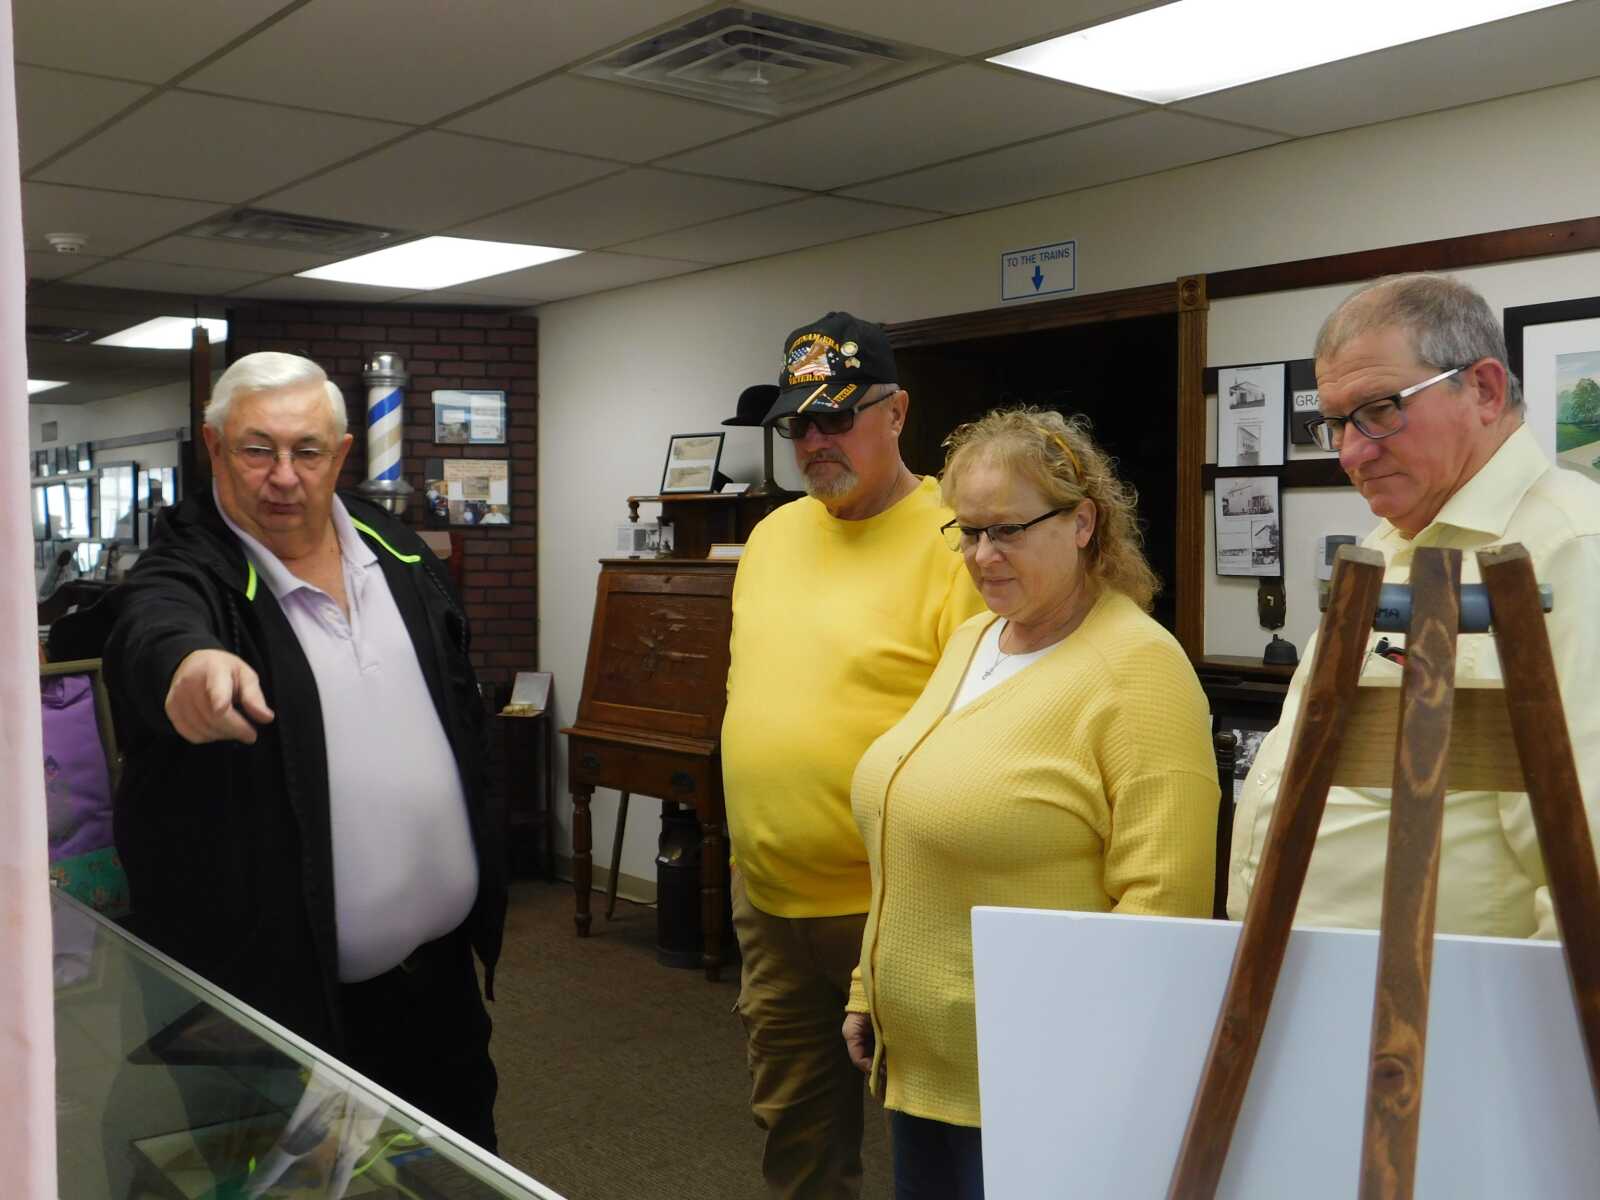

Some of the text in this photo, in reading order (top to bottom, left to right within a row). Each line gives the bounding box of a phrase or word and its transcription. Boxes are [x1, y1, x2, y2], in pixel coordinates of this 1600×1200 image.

[1007, 247, 1070, 268] TO THE TRAINS
